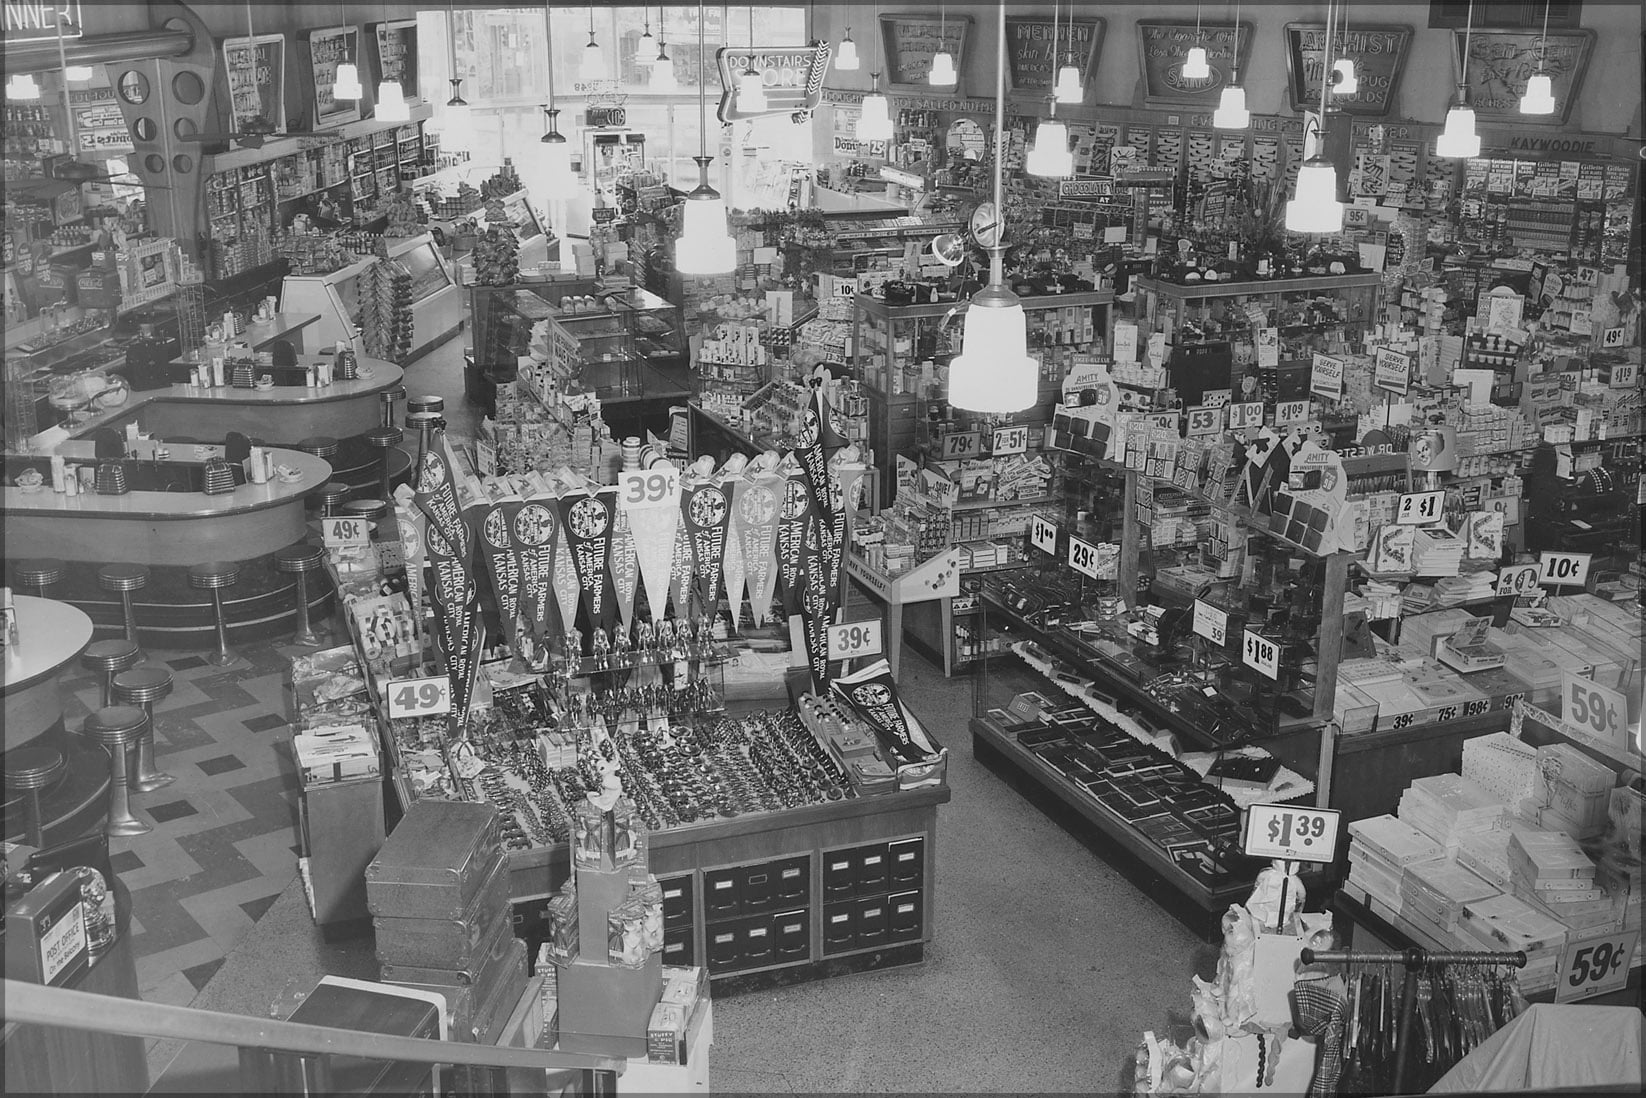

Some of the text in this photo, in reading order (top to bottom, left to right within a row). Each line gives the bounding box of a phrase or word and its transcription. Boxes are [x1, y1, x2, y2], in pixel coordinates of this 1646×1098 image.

[1017, 24, 1089, 41] MENNEN
[1017, 41, 1038, 60] skin
[1170, 44, 1188, 57] Tha
[735, 67, 807, 87] SORE
[1167, 67, 1214, 88] SANO
[916, 99, 957, 110] SALTED
[960, 101, 1019, 113] NUTMETS
[1510, 137, 1596, 153] KAYWOODIE
[1606, 330, 1621, 343] 49¢
[1315, 364, 1341, 378] YOURSELF
[1319, 358, 1337, 369] SERVE
[1380, 358, 1407, 373] YOURSELF
[1384, 353, 1404, 364] SERVE
[1077, 374, 1098, 382] AMITY
[950, 436, 973, 453] 79¢
[1306, 453, 1329, 462] AMITY
[804, 451, 823, 502] KANSAS CITY
[812, 443, 826, 486] AMERICAN
[440, 482, 457, 518] FUTURE
[626, 475, 675, 503] 39¢
[426, 499, 454, 540] KANSAS CITY
[438, 503, 455, 533] AMERICA
[1420, 496, 1436, 516] $1
[333, 520, 360, 539] 49¢
[818, 518, 827, 547] KANSAS
[576, 544, 586, 574] KANSAS
[674, 542, 682, 577] AMERICA
[694, 532, 704, 562] KANSAS
[702, 540, 710, 574] AMERICA
[756, 525, 772, 599] FUTURE FARMERS
[778, 524, 790, 579] KANSAS CITY
[788, 520, 804, 588] AMERICAN ROYAL
[830, 512, 845, 587] FUTURE FARMERS
[1073, 543, 1094, 568] 29¢
[520, 550, 532, 581] KANSAS
[530, 558, 538, 594] AMERICA
[555, 548, 566, 585] KANSAS
[566, 548, 577, 590] MERICAN
[585, 551, 593, 587] AMERICA
[593, 537, 606, 614] FUTURE FARMERS
[611, 538, 625, 594] KANSAS CITY
[624, 533, 636, 604] AMERICAN ROYAL
[680, 533, 693, 604] UTURE FARMERS
[708, 526, 723, 602] FUTURE FARMERS
[807, 555, 818, 591] KANSAS
[1503, 573, 1512, 585] 4
[1547, 558, 1580, 578] 10¢
[437, 561, 455, 618] KANSAS CITY
[450, 557, 464, 627] AMERICAN ROYAL
[493, 553, 509, 610] KANSAS CITY
[506, 549, 519, 620] AMERICAN ROYAL
[536, 544, 551, 622] FUTURE FARMERS
[838, 626, 871, 651] 39¢
[450, 655, 458, 671] CITY
[394, 683, 446, 711] 49¢
[1571, 684, 1618, 736] 59¢
[1393, 713, 1414, 729] 39¢
[1438, 706, 1456, 721] 75¢
[1469, 700, 1488, 716] 98¢
[47, 922, 79, 961] POST OFFICE
[1569, 942, 1625, 986] 59¢
